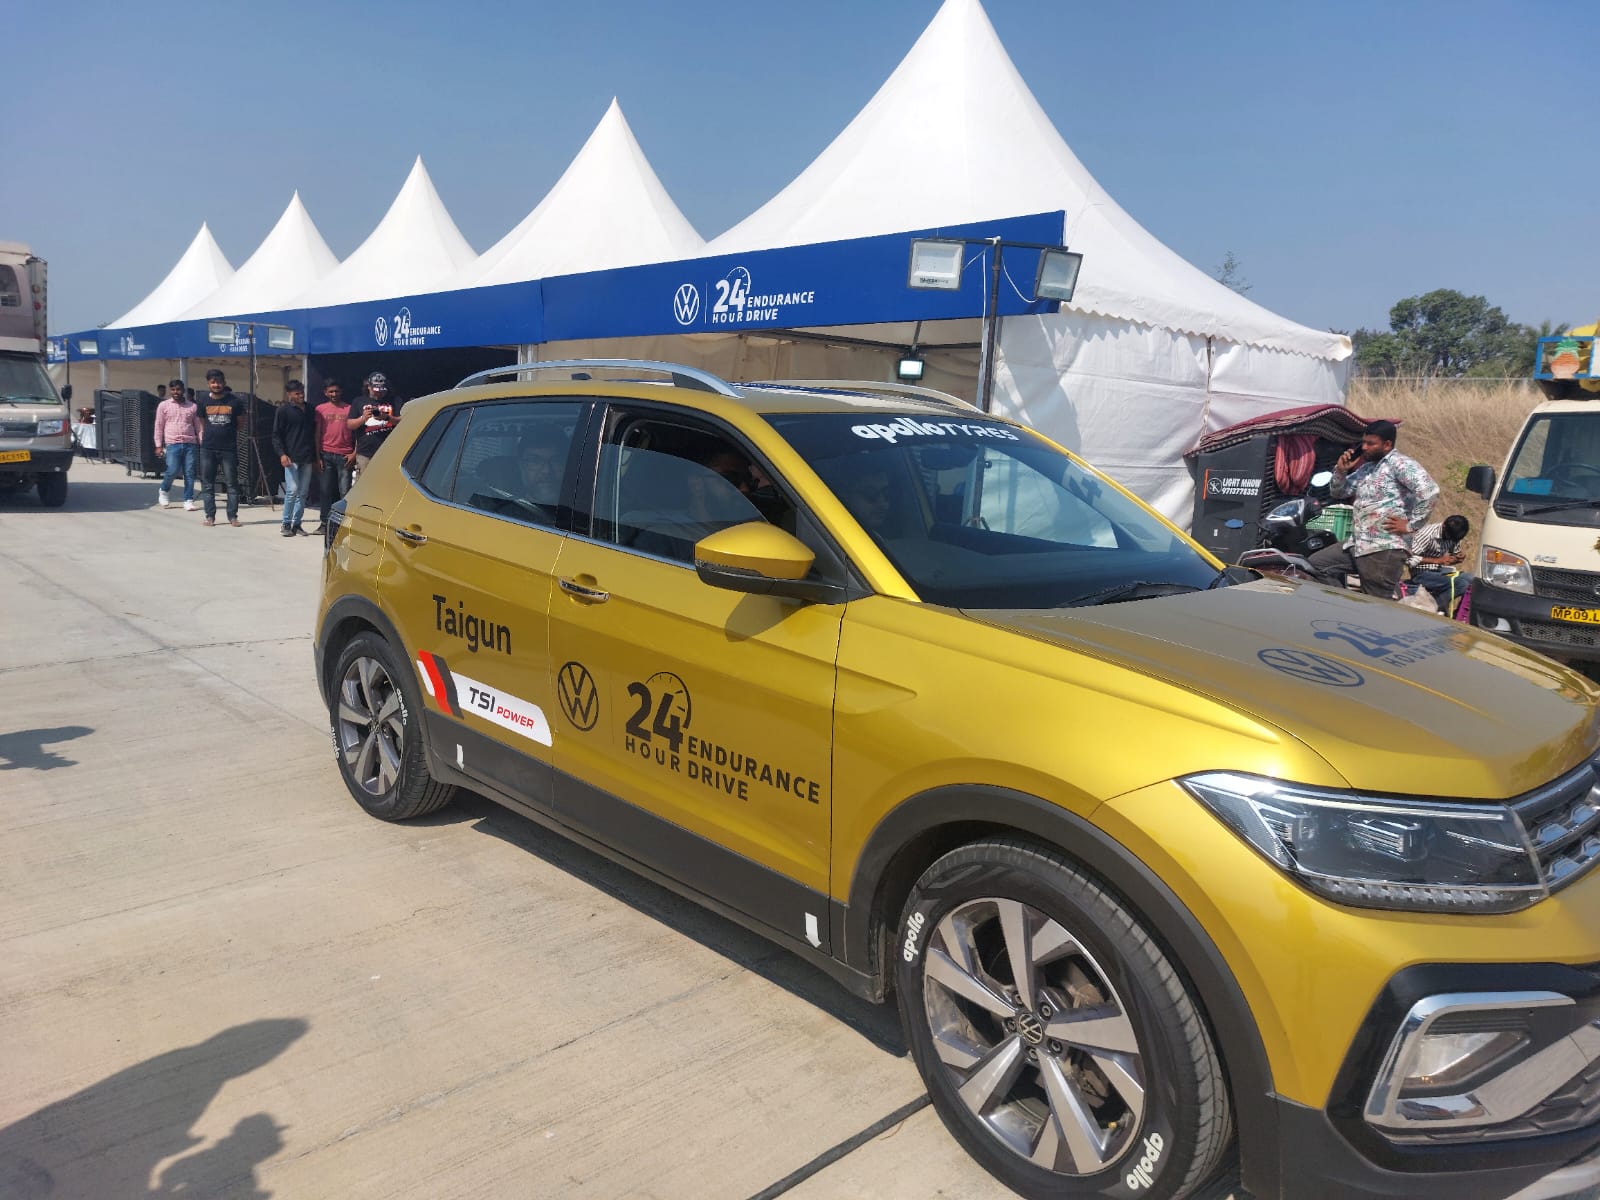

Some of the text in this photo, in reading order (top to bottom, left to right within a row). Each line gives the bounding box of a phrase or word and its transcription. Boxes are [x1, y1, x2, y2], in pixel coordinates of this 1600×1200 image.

[712, 308, 778, 324] HOUR DRIVE
[713, 278, 746, 313] 24
[747, 291, 815, 308] ENDURANCE
[394, 315, 409, 339] 24
[409, 325, 441, 337] ENDURANCE
[1222, 478, 1240, 487] LIGHT
[433, 594, 512, 655] Taigun
[469, 686, 535, 729] TSI POWER
[625, 681, 684, 754] 24
[625, 735, 748, 801] HOUR DRIVE
[688, 735, 820, 804] ENDURANCE
[903, 912, 925, 962] apollo
[1126, 1132, 1164, 1190] apollo
